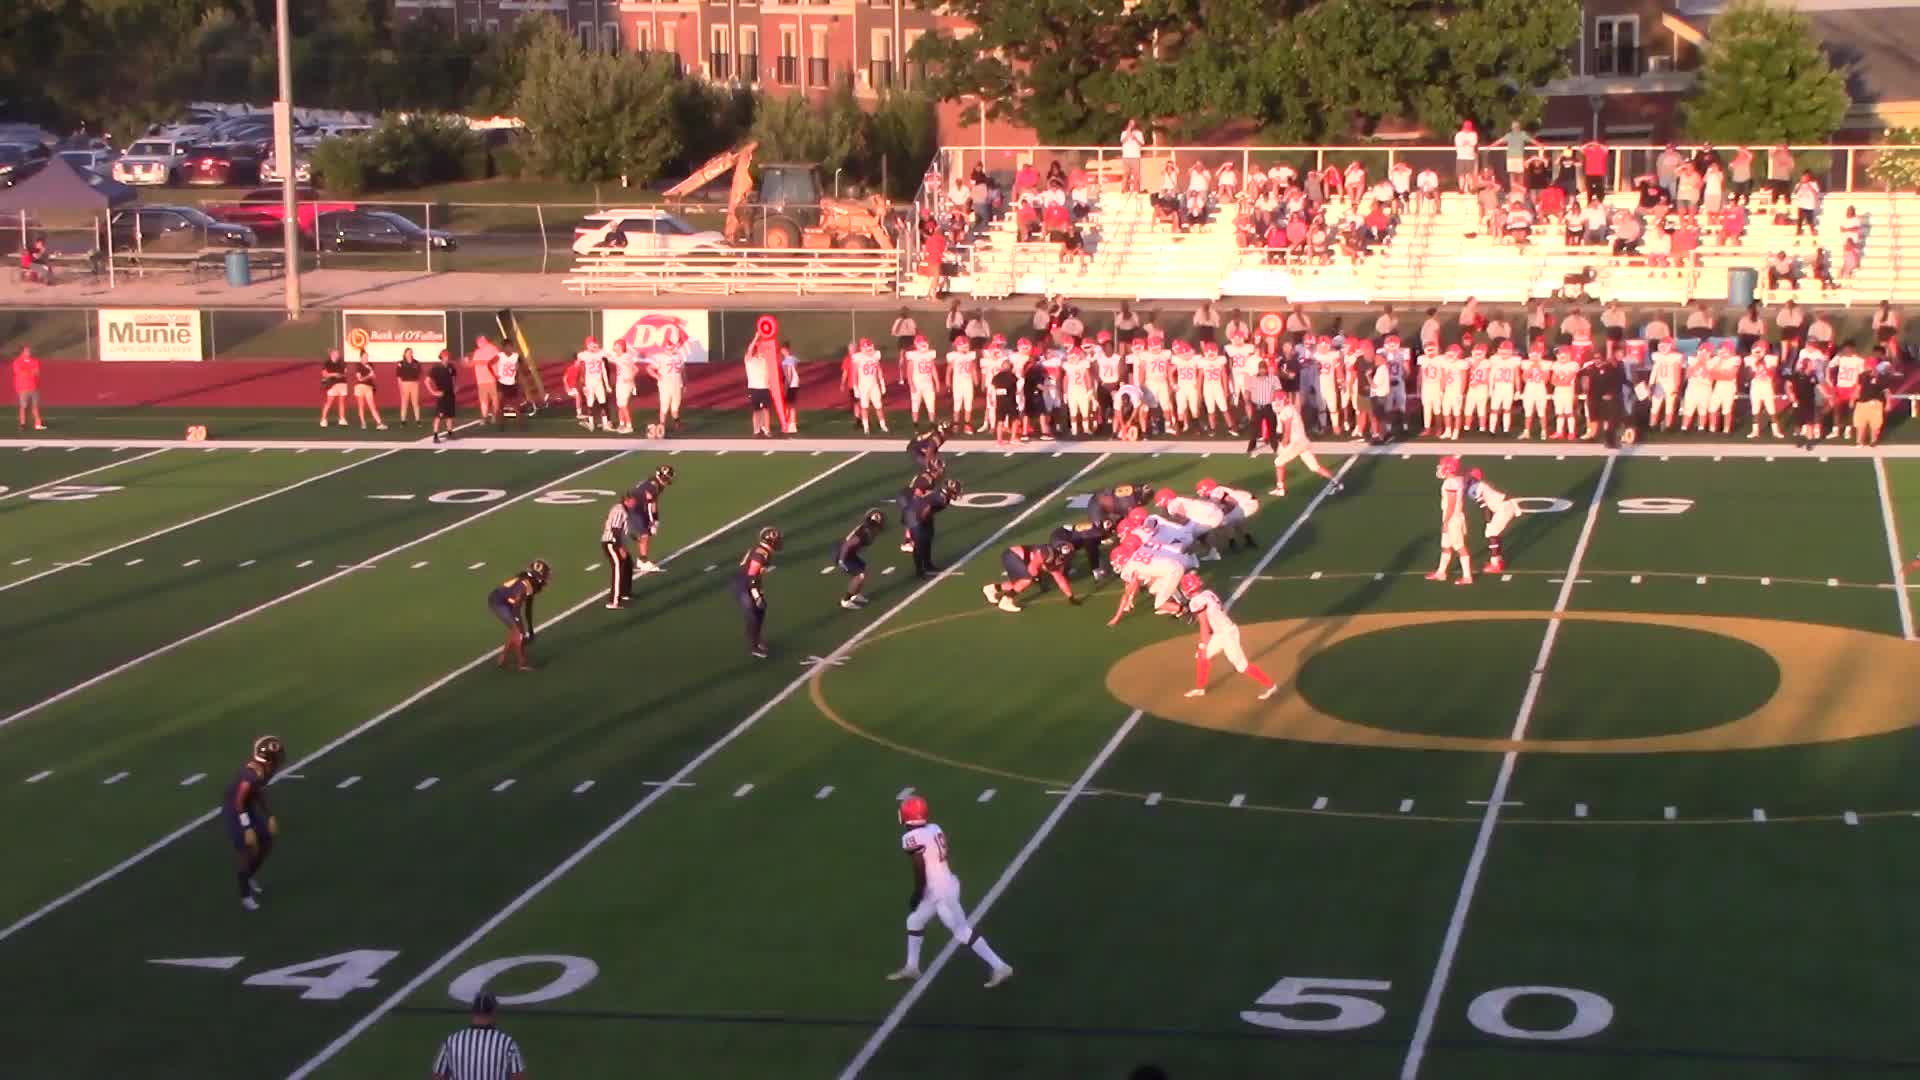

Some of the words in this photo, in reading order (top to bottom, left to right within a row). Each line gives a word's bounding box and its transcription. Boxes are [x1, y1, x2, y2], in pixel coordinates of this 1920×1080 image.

[108, 321, 192, 345] Munie
[633, 323, 680, 348] DQ
[647, 424, 665, 439] 30
[1239, 976, 1615, 1041] 50
